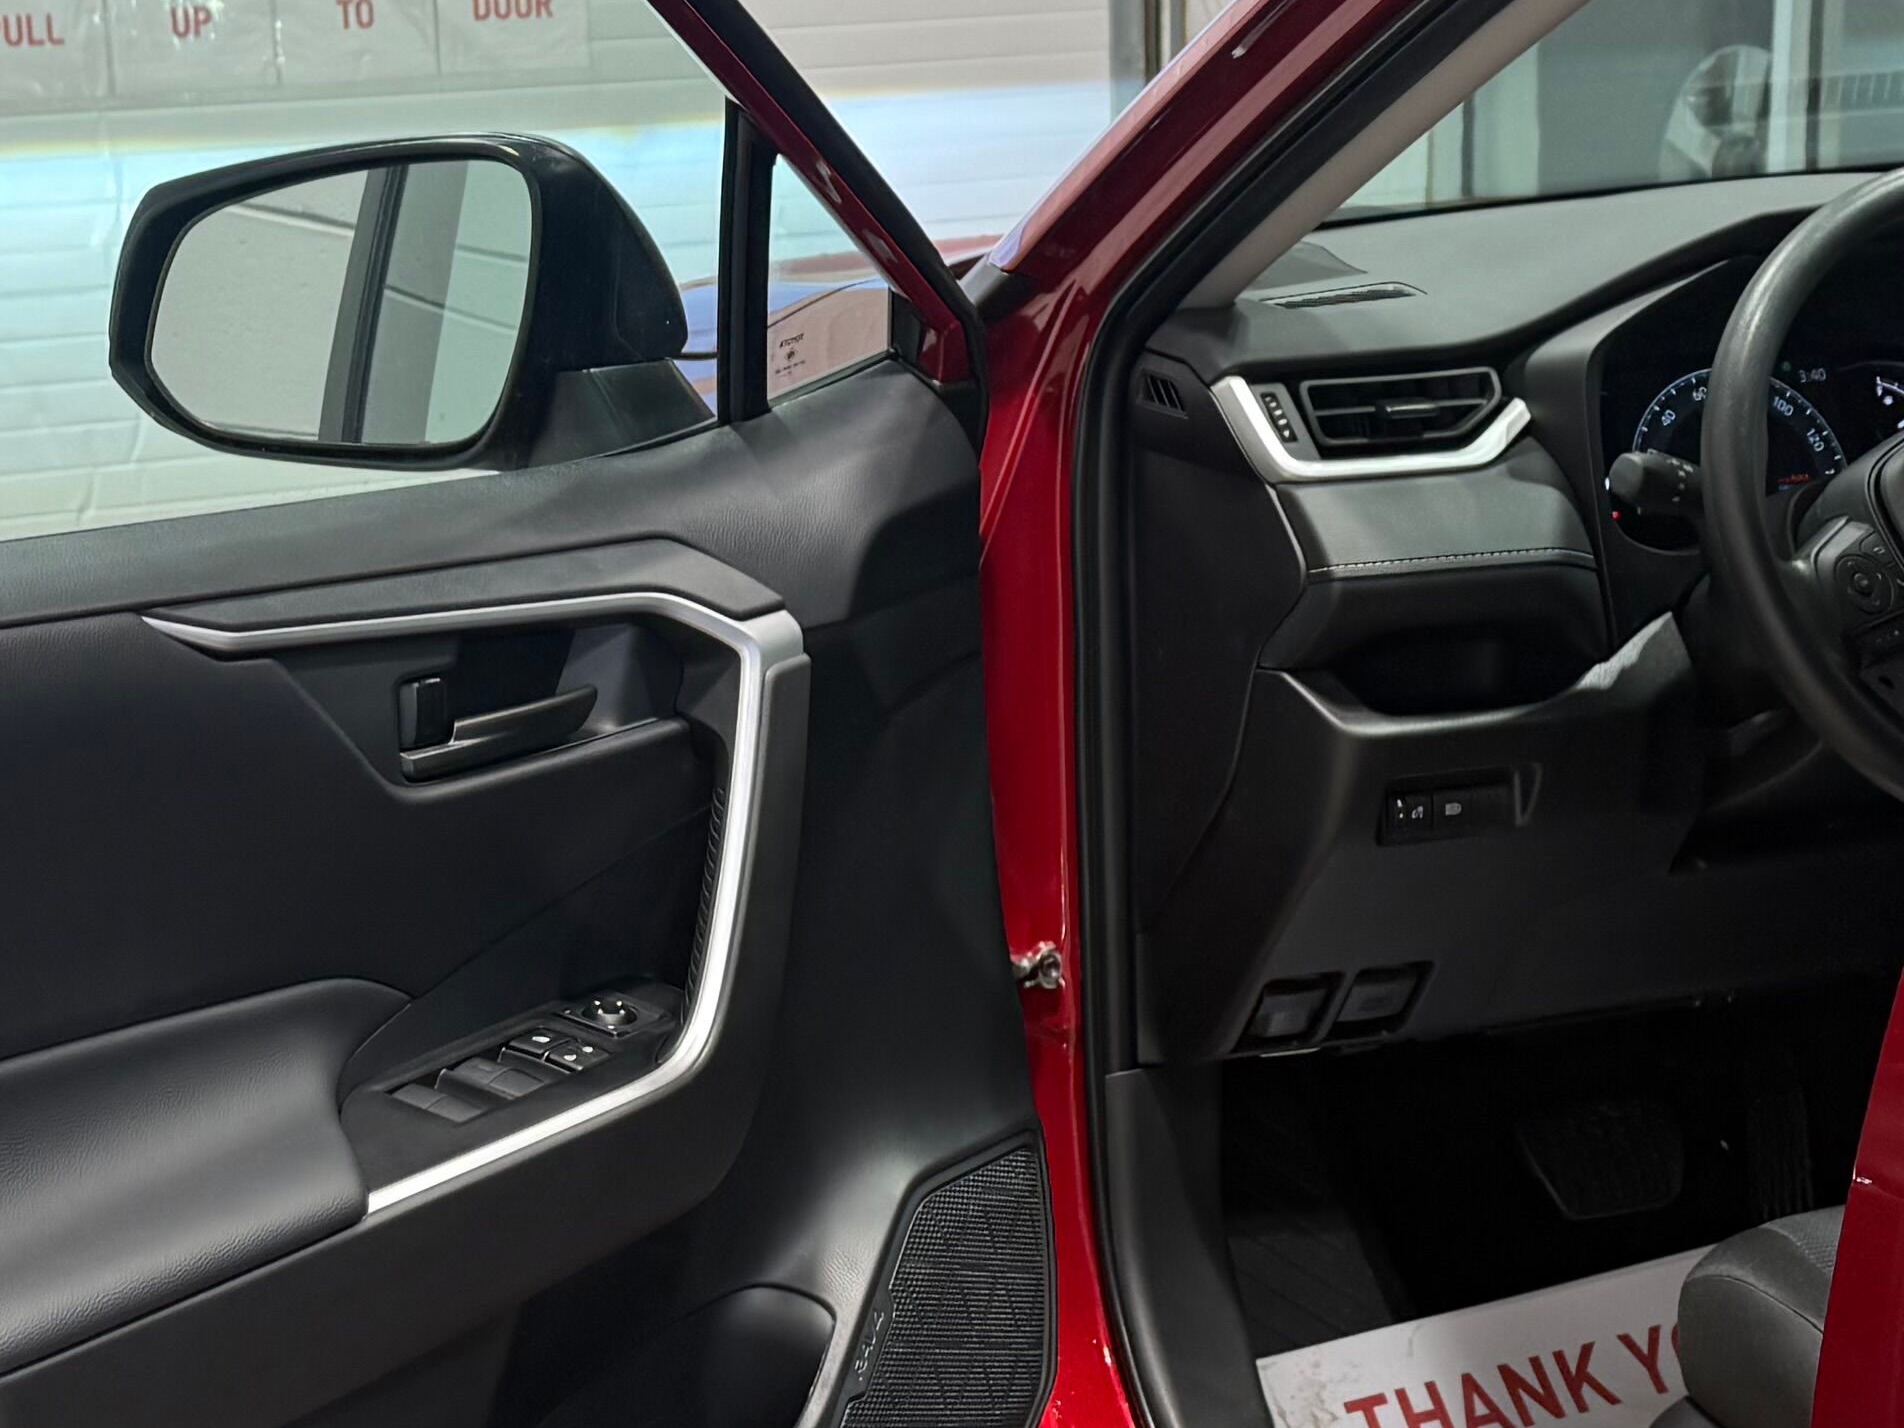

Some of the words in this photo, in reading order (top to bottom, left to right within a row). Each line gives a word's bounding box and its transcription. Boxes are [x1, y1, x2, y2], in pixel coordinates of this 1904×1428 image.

[171, 6, 213, 39] UP
[1772, 395, 1794, 417] 100
[1661, 409, 1676, 427] 40
[1806, 428, 1825, 452] 120
